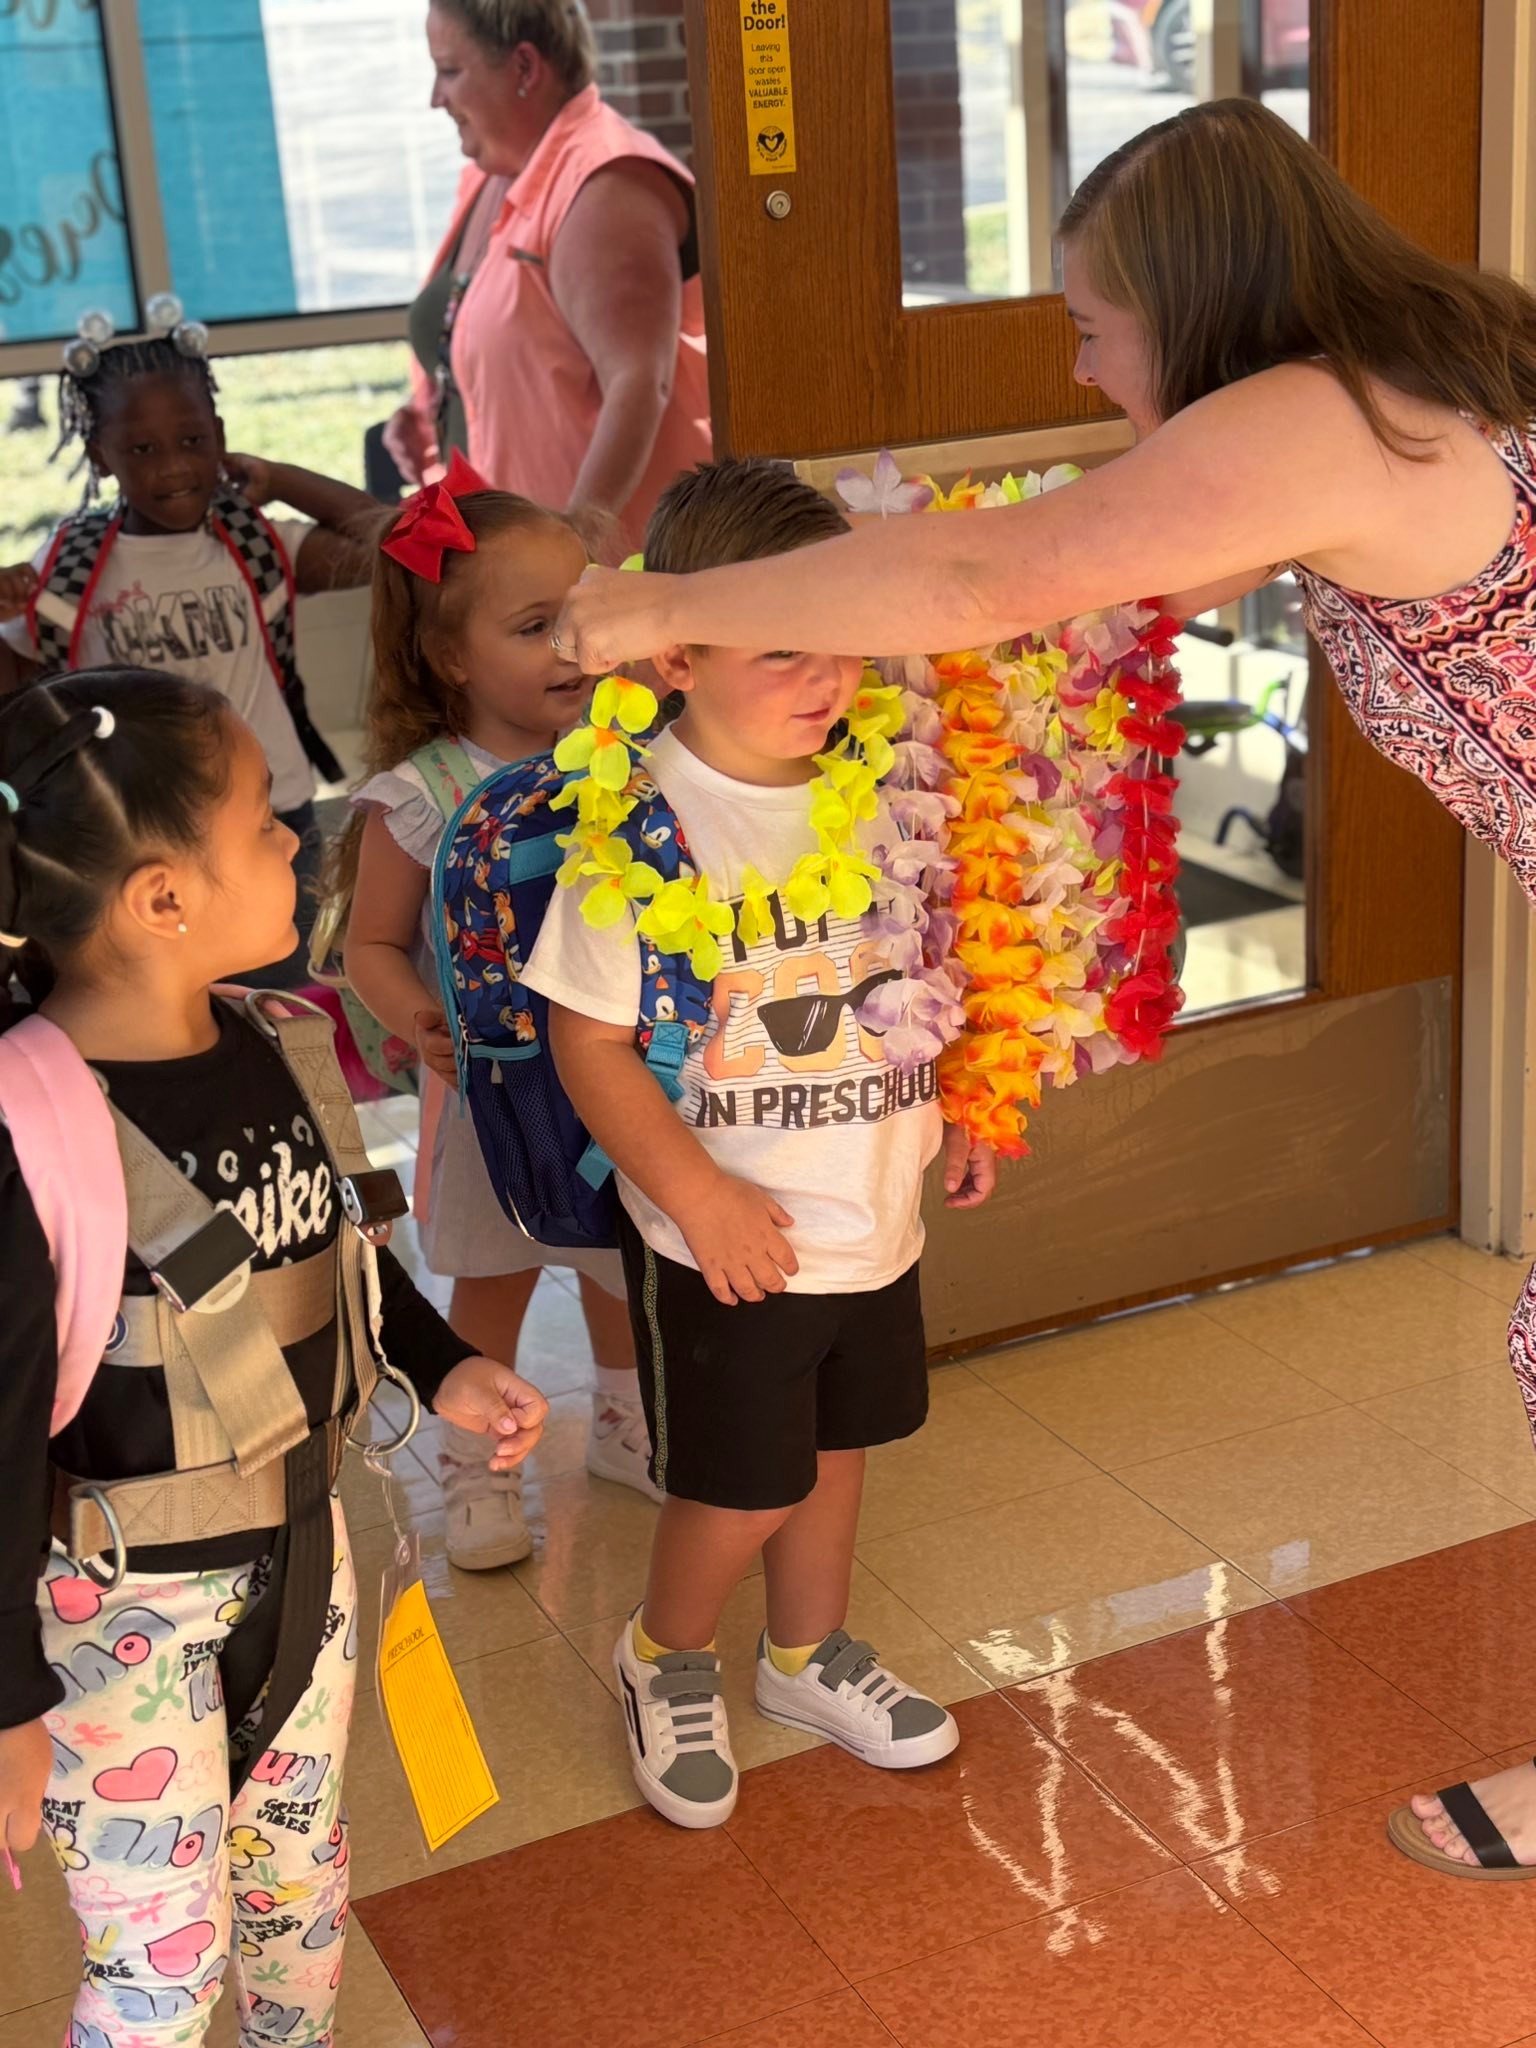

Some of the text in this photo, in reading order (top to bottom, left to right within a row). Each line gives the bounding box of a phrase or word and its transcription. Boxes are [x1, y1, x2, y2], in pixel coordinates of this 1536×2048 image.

[751, 0, 776, 15] the
[744, 14, 785, 31] Door!
[751, 43, 780, 53] Leaving
[760, 55, 773, 63] this
[749, 66, 786, 75] door open
[755, 78, 781, 86] wastes
[749, 87, 788, 98] VALUABLE
[753, 100, 786, 109] ENERGY.
[695, 1058, 939, 1129] IN PRESCHOO
[43, 1798, 86, 1818] REAT
[264, 1799, 322, 1818] GREAT
[256, 1809, 311, 1835] VIBES
